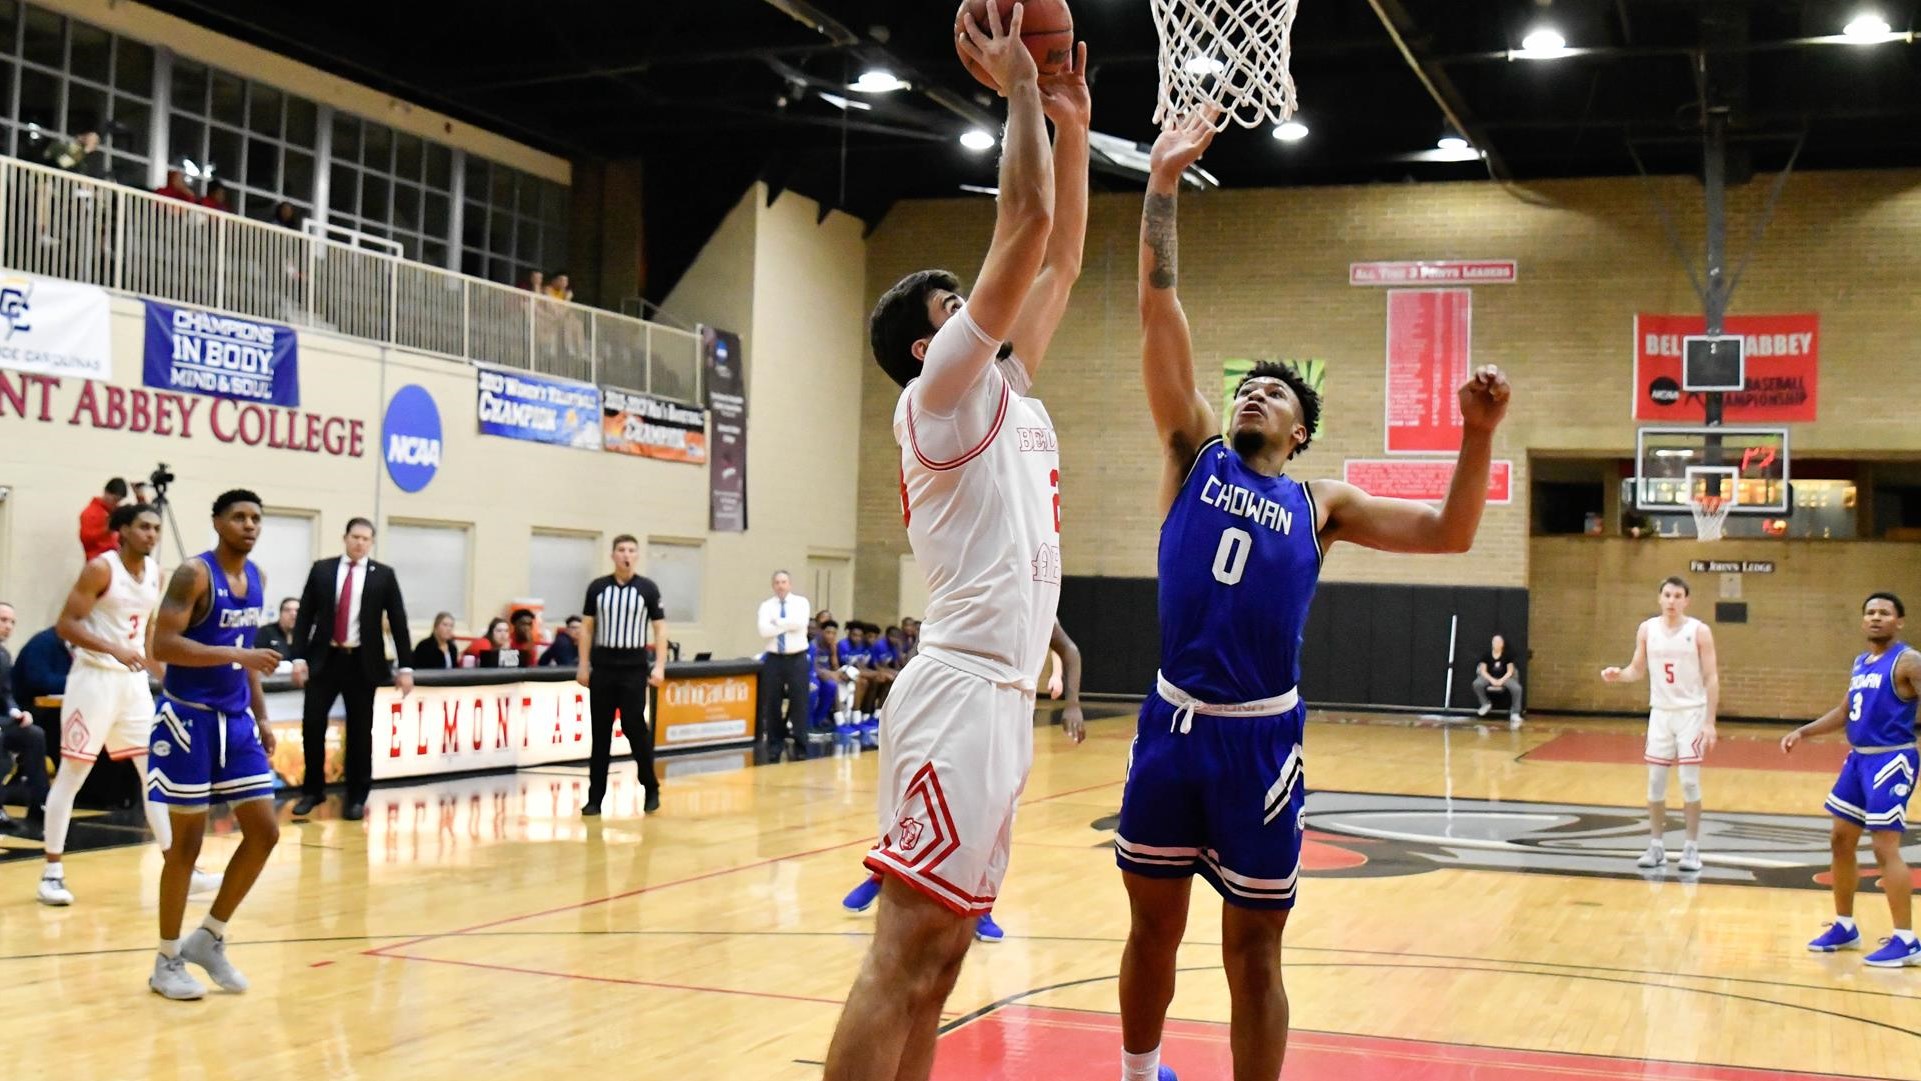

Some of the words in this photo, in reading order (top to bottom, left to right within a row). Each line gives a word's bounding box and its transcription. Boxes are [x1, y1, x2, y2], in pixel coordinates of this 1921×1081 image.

[173, 309, 274, 344] CHAMPIONS
[172, 334, 201, 362] IN
[1745, 333, 1812, 356] ABBEY
[170, 367, 217, 391] MIND
[217, 374, 230, 393] &
[230, 376, 272, 399] SOUL
[69, 379, 199, 438] ABBEY
[210, 397, 364, 457] COLLEGE
[388, 433, 440, 467] NCAA
[1200, 473, 1293, 536] CHOWAN
[1211, 526, 1253, 586] 0
[128, 614, 139, 640] 3
[1664, 663, 1675, 684] 5
[1848, 691, 1863, 722] 3
[389, 697, 532, 758] ELMONT
